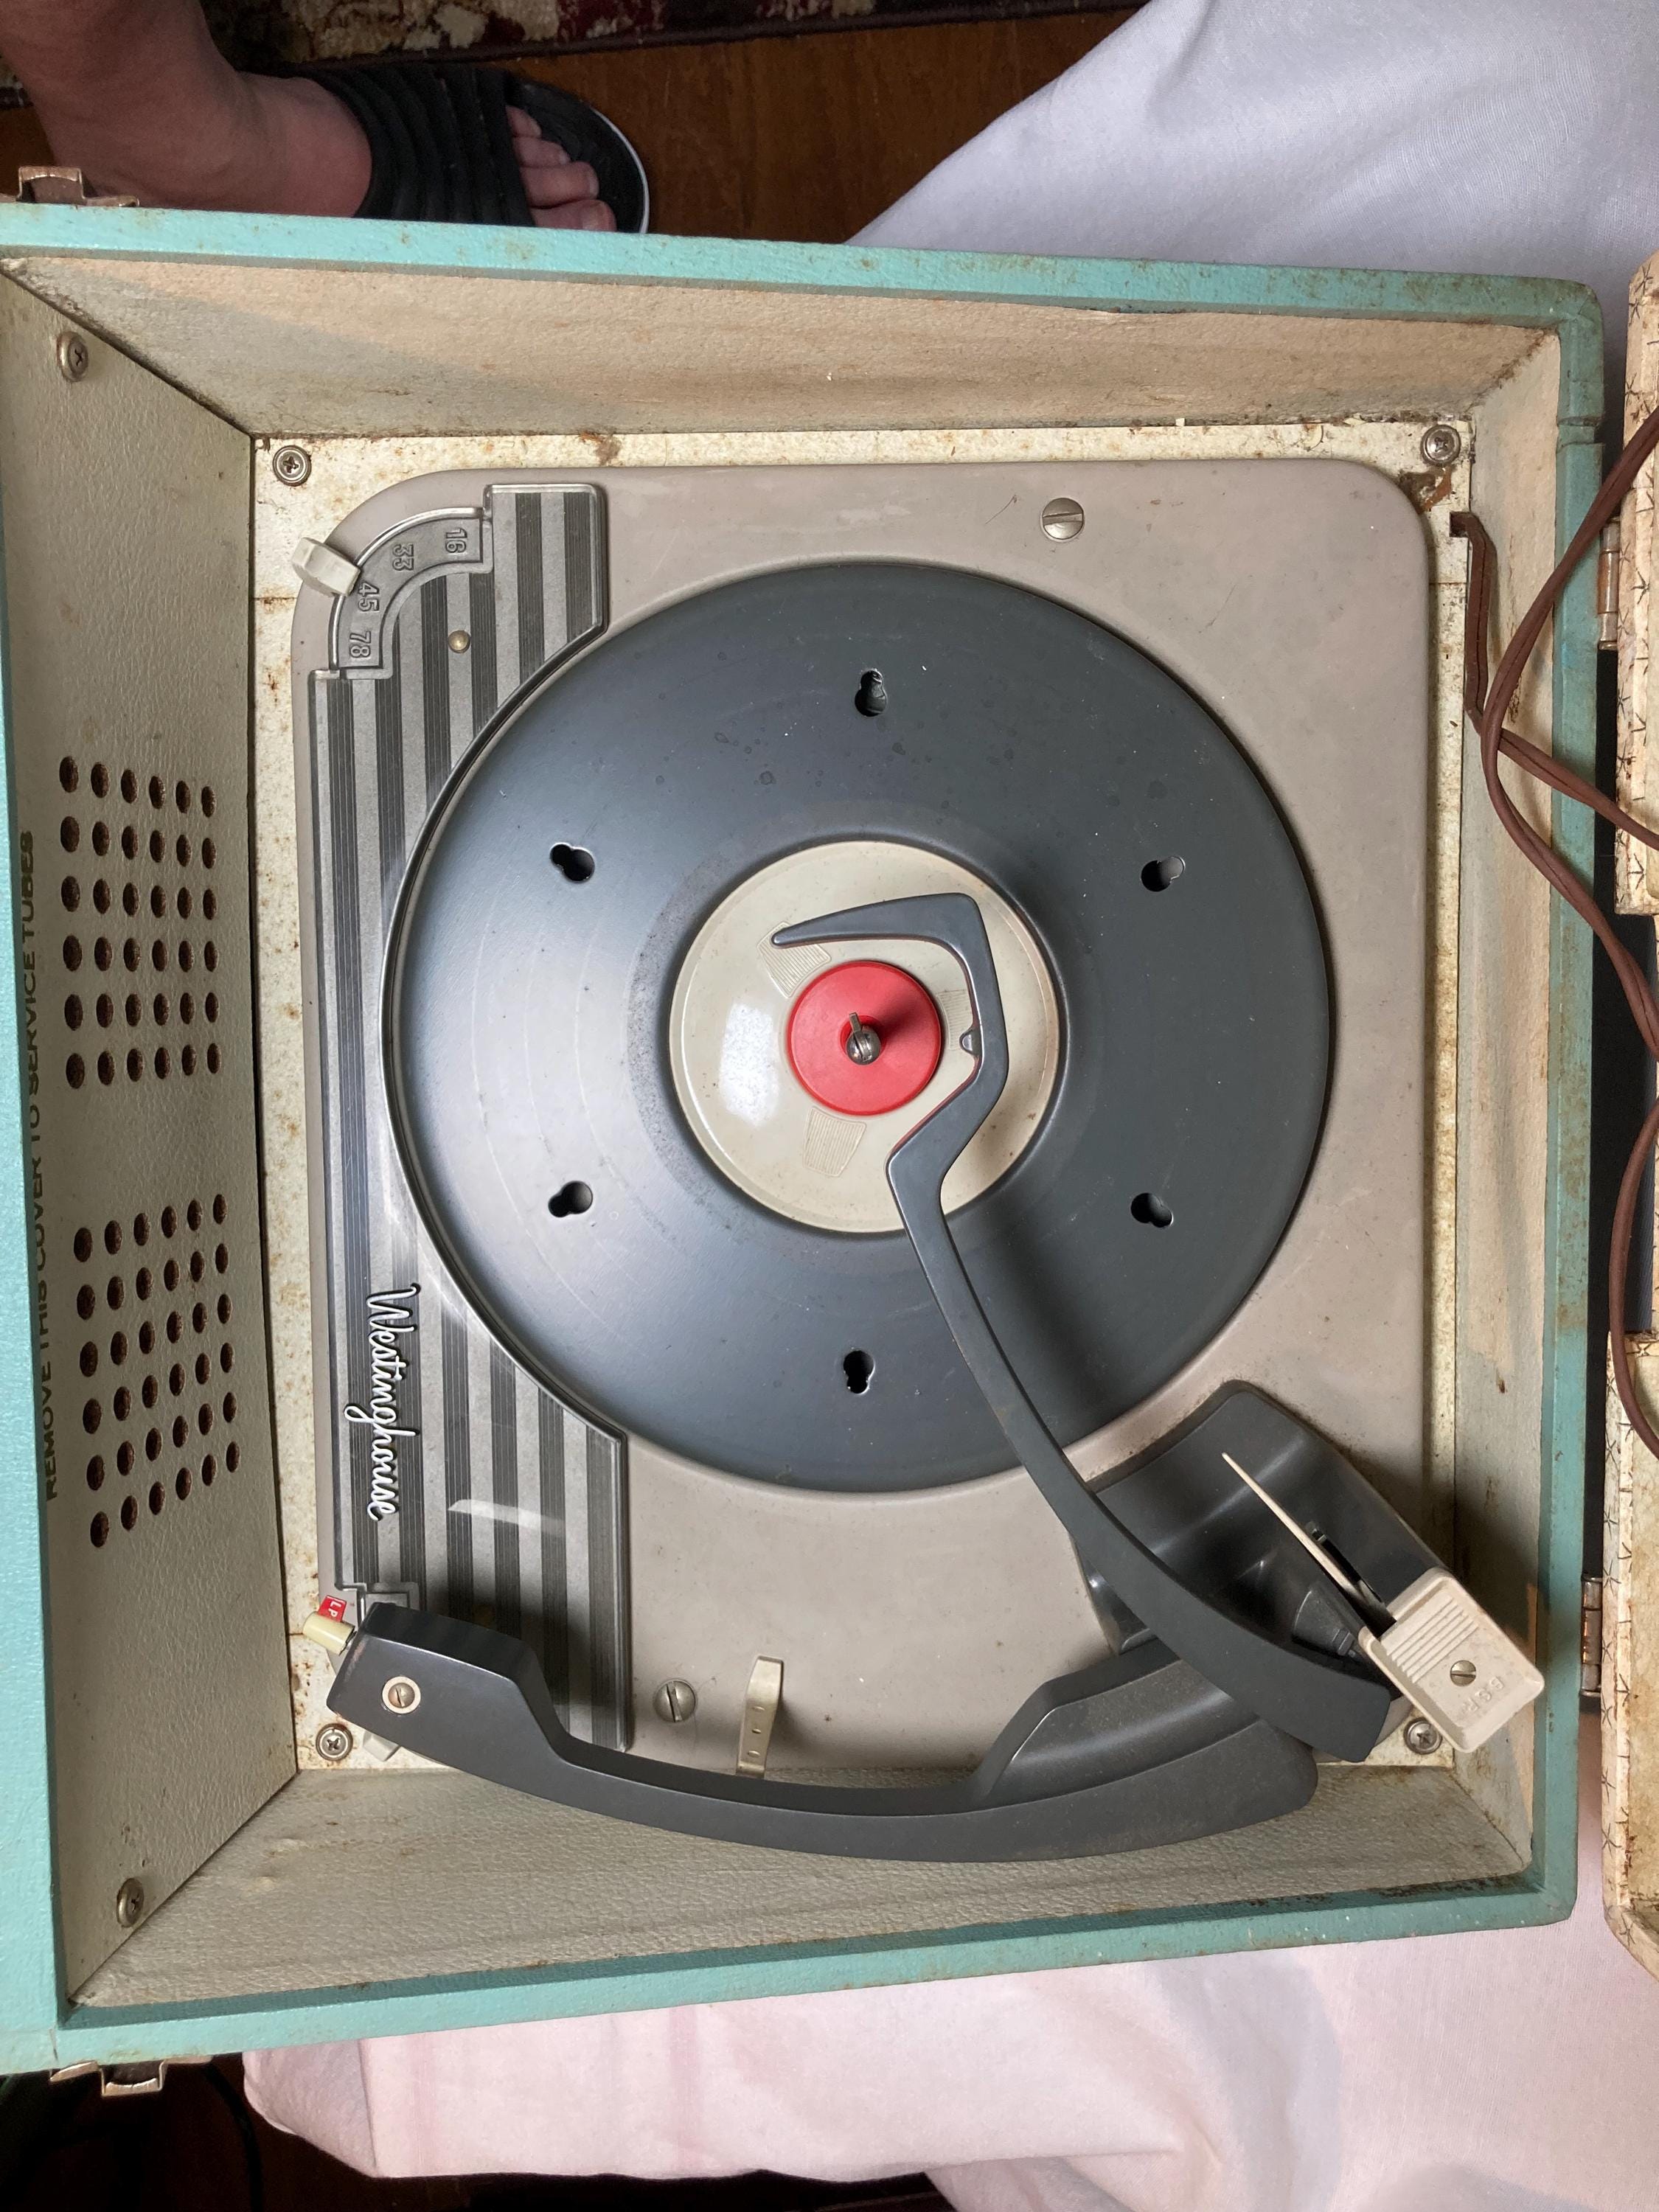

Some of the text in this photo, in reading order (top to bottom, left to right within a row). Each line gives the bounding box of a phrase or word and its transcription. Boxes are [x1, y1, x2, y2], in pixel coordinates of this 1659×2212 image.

[445, 527, 467, 554] 16
[392, 543, 414, 572] 33
[358, 582, 380, 613] 45
[349, 630, 371, 660] 78
[20, 831, 57, 1501] REMOVE THIS COVER TO SERVICE TUBES
[344, 1283, 422, 1521] Westinghouse
[328, 1601, 342, 1618] LP
